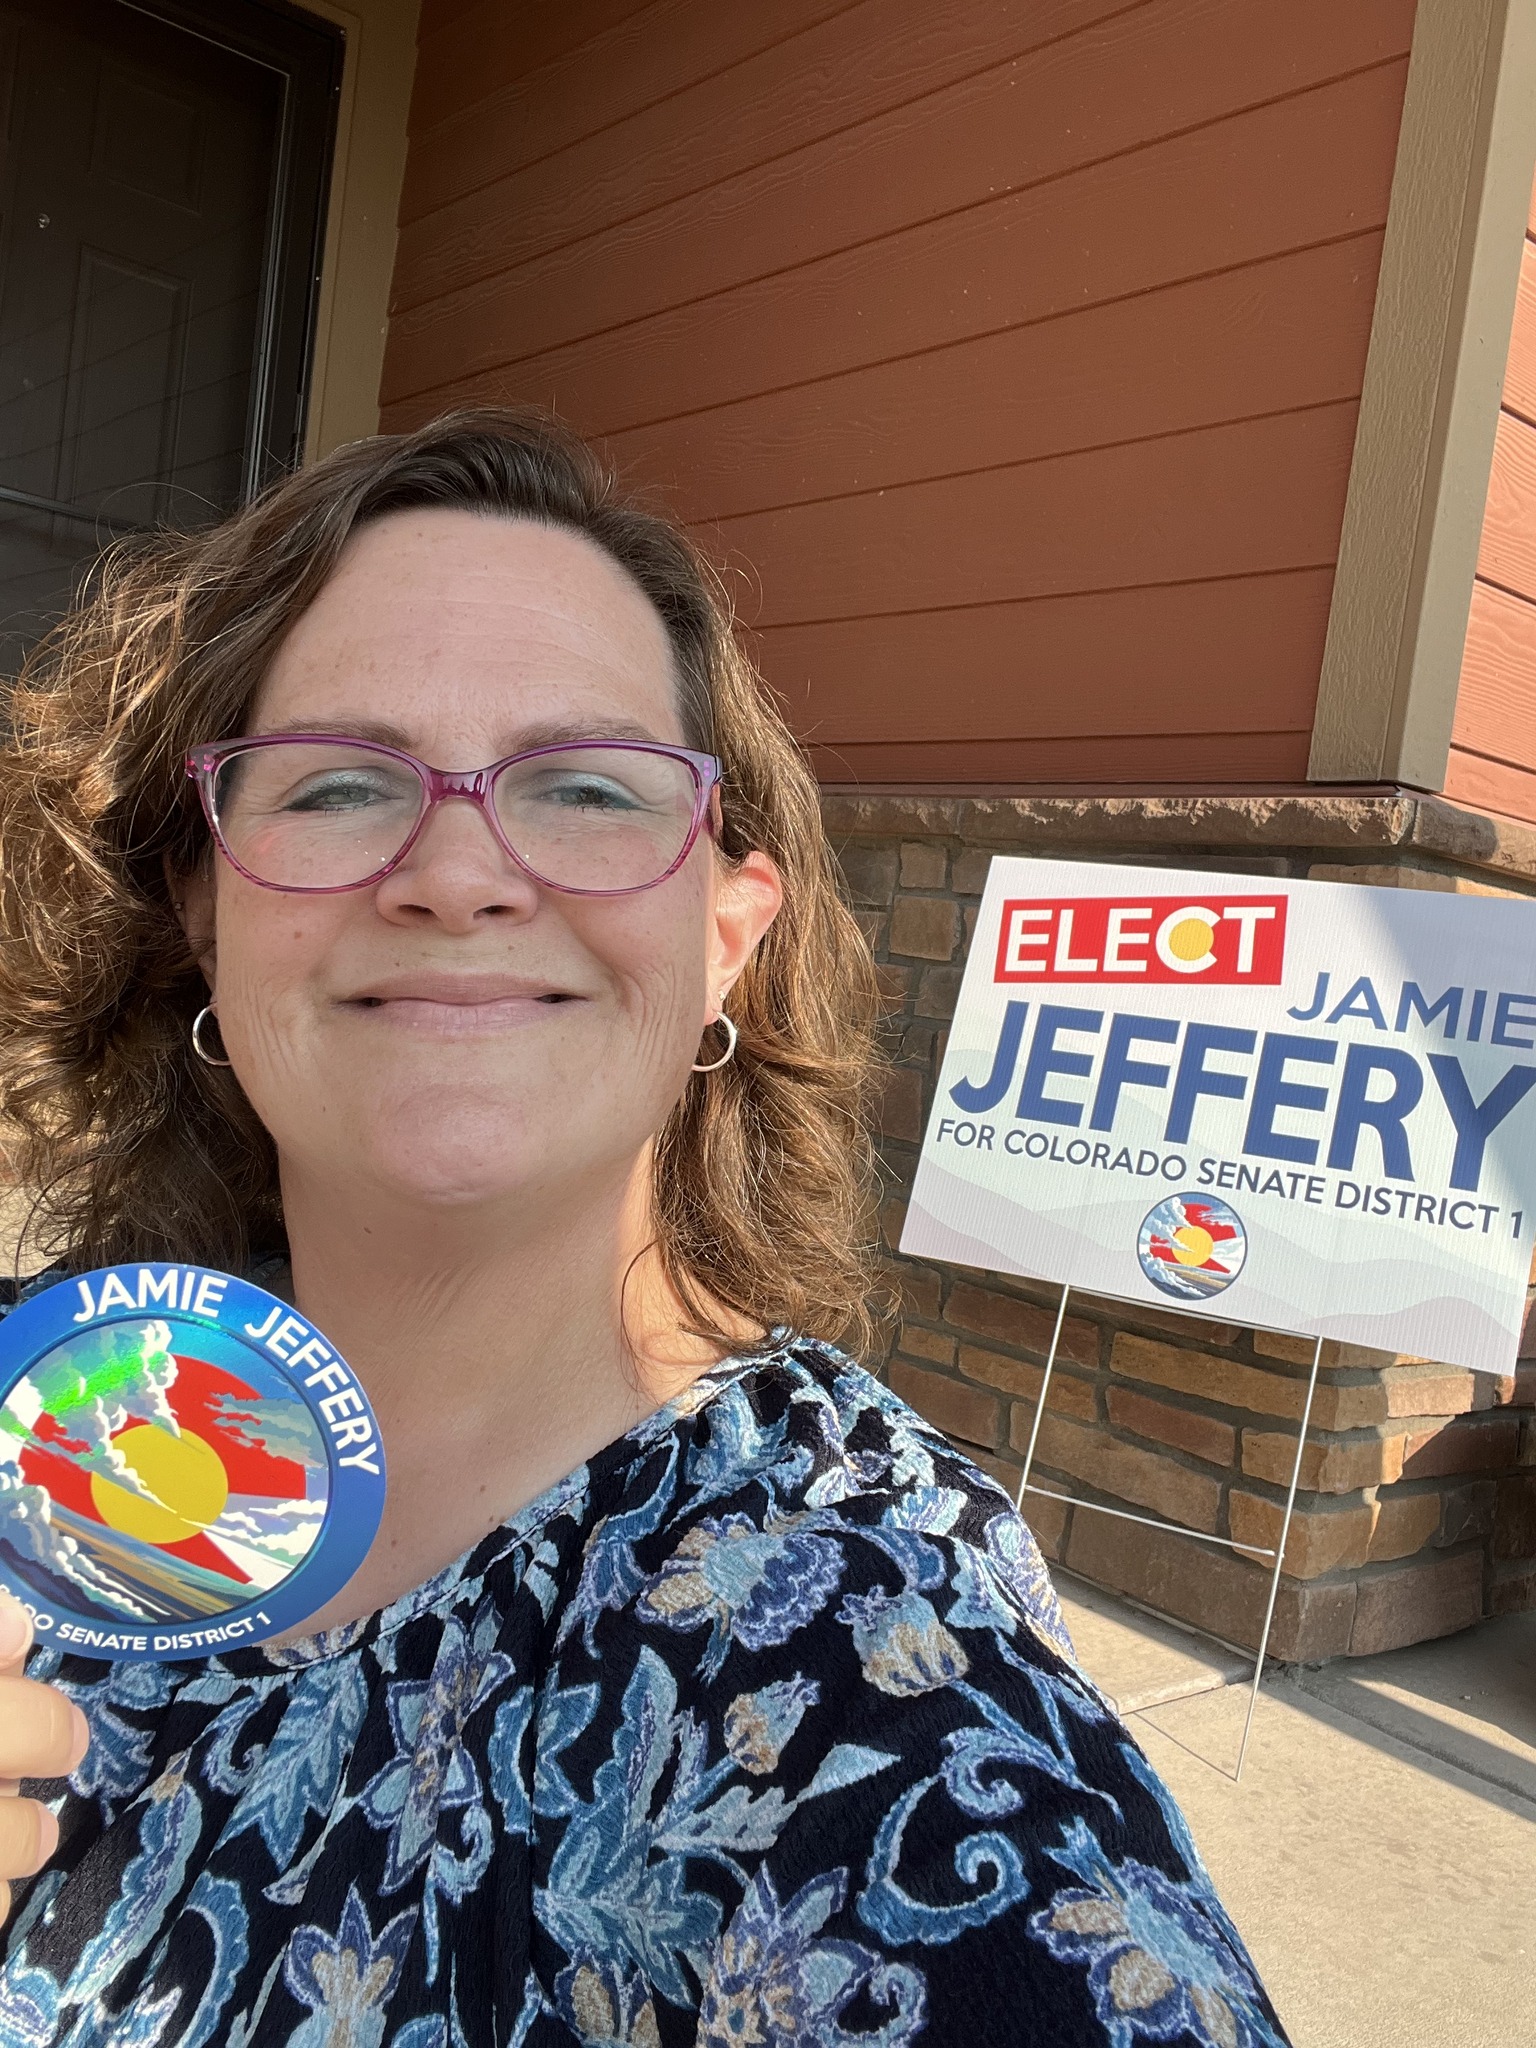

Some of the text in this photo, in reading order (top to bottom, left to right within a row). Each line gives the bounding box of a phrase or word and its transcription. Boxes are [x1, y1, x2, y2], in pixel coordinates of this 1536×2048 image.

[1003, 905, 1277, 975] ELECT
[1286, 972, 1536, 1050] JAMIE
[948, 999, 1536, 1194] JEFFERY
[936, 1118, 1524, 1240] FOR COLORADO SENATE DISTRICT 1
[73, 1268, 381, 1476] JAMIE JEFFERY
[56, 1611, 272, 1652] SENATE DISTRICT 1
